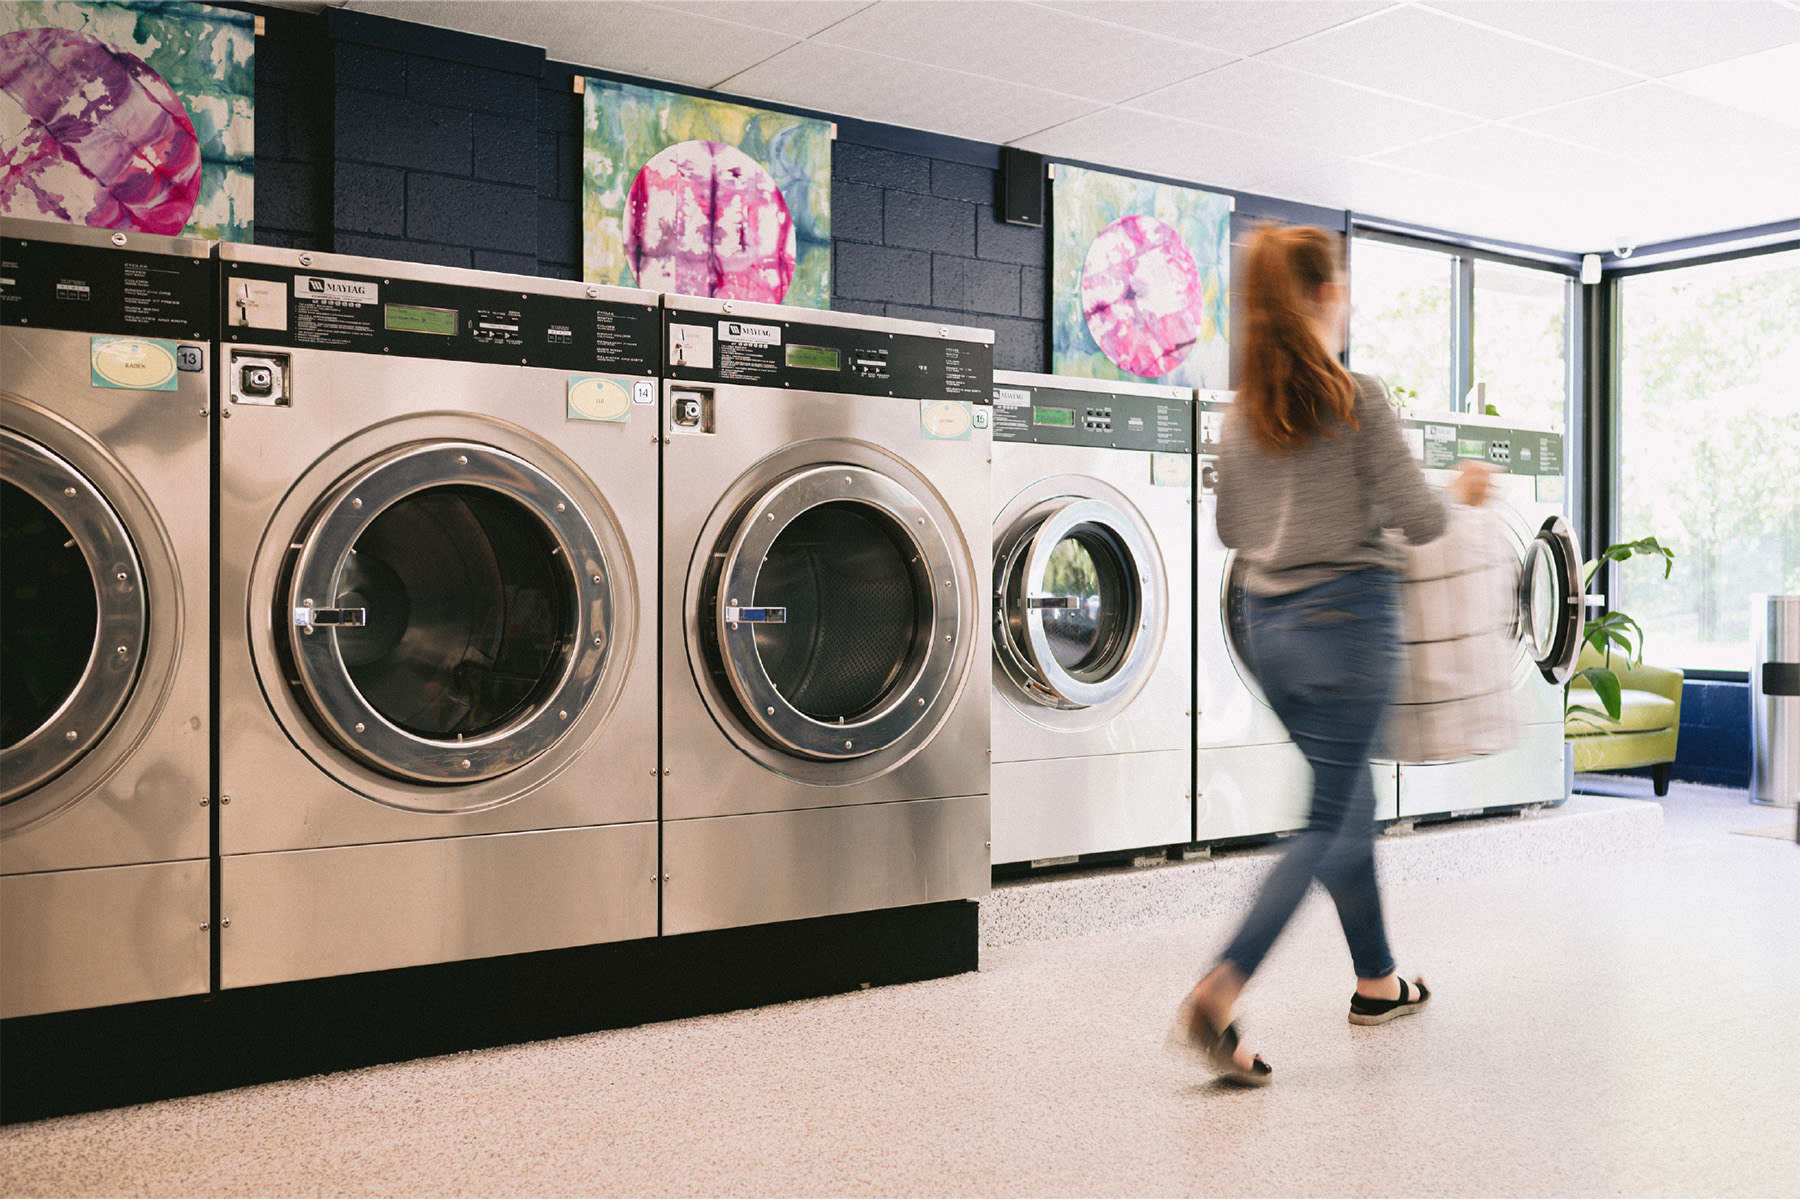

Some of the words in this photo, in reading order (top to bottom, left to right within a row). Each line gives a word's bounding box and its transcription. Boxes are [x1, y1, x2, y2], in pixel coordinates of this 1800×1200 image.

[326, 283, 365, 295] MAYTAG
[742, 328, 771, 337] MAYTAG
[181, 352, 197, 365] 13
[638, 388, 649, 398] 14
[976, 414, 986, 424] 15
